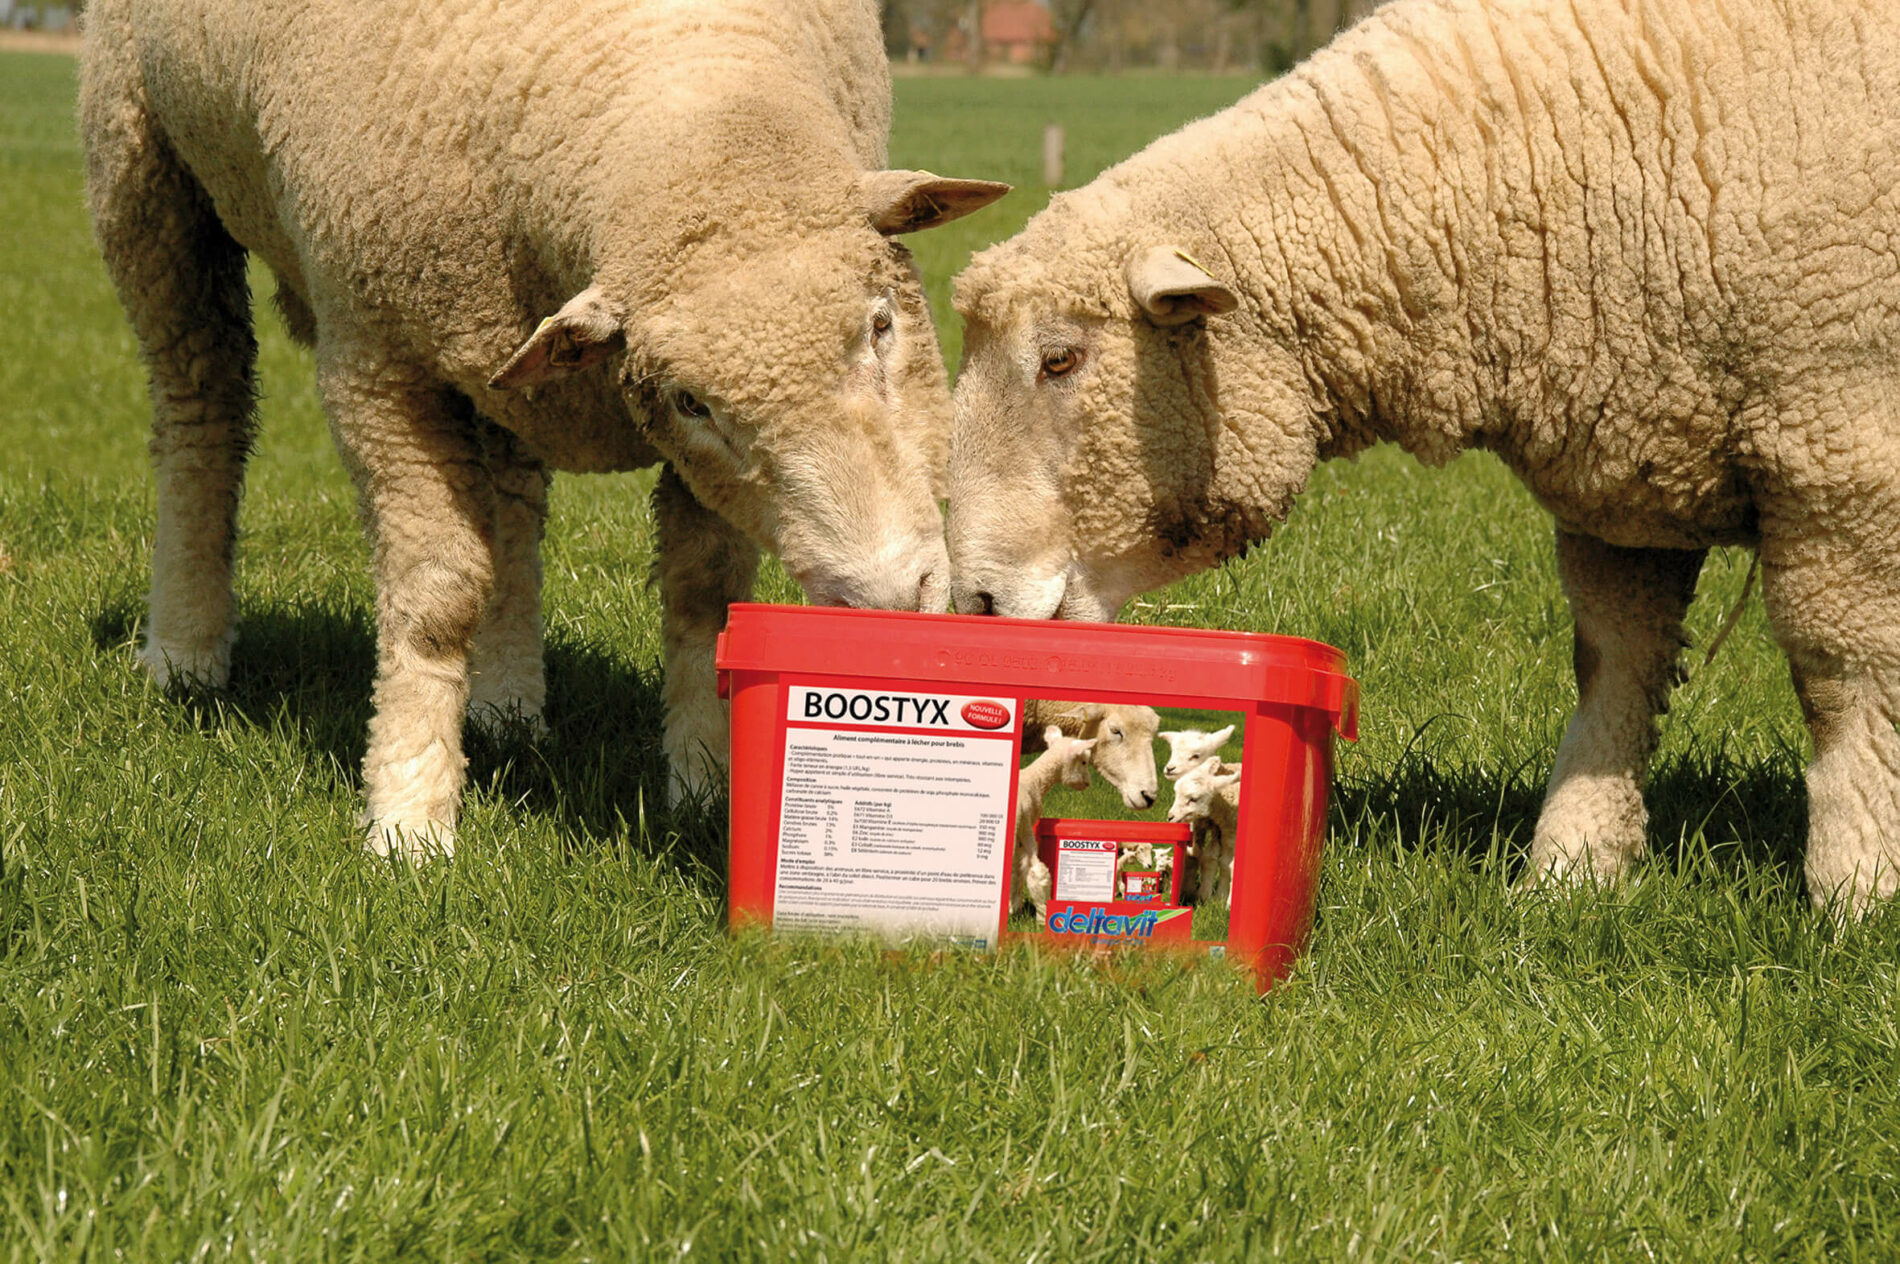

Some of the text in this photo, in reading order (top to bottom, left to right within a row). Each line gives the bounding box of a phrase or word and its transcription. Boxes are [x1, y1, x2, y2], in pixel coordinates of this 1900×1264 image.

[804, 691, 950, 725] BOOSTYX
[970, 703, 1002, 715] NOUVELLE
[967, 712, 998, 724] FORMULE
[833, 734, 857, 742] Aliment
[858, 736, 906, 745] complémentaire
[1063, 840, 1100, 849] BOOSTYX
[1050, 906, 1158, 937] deltavit
